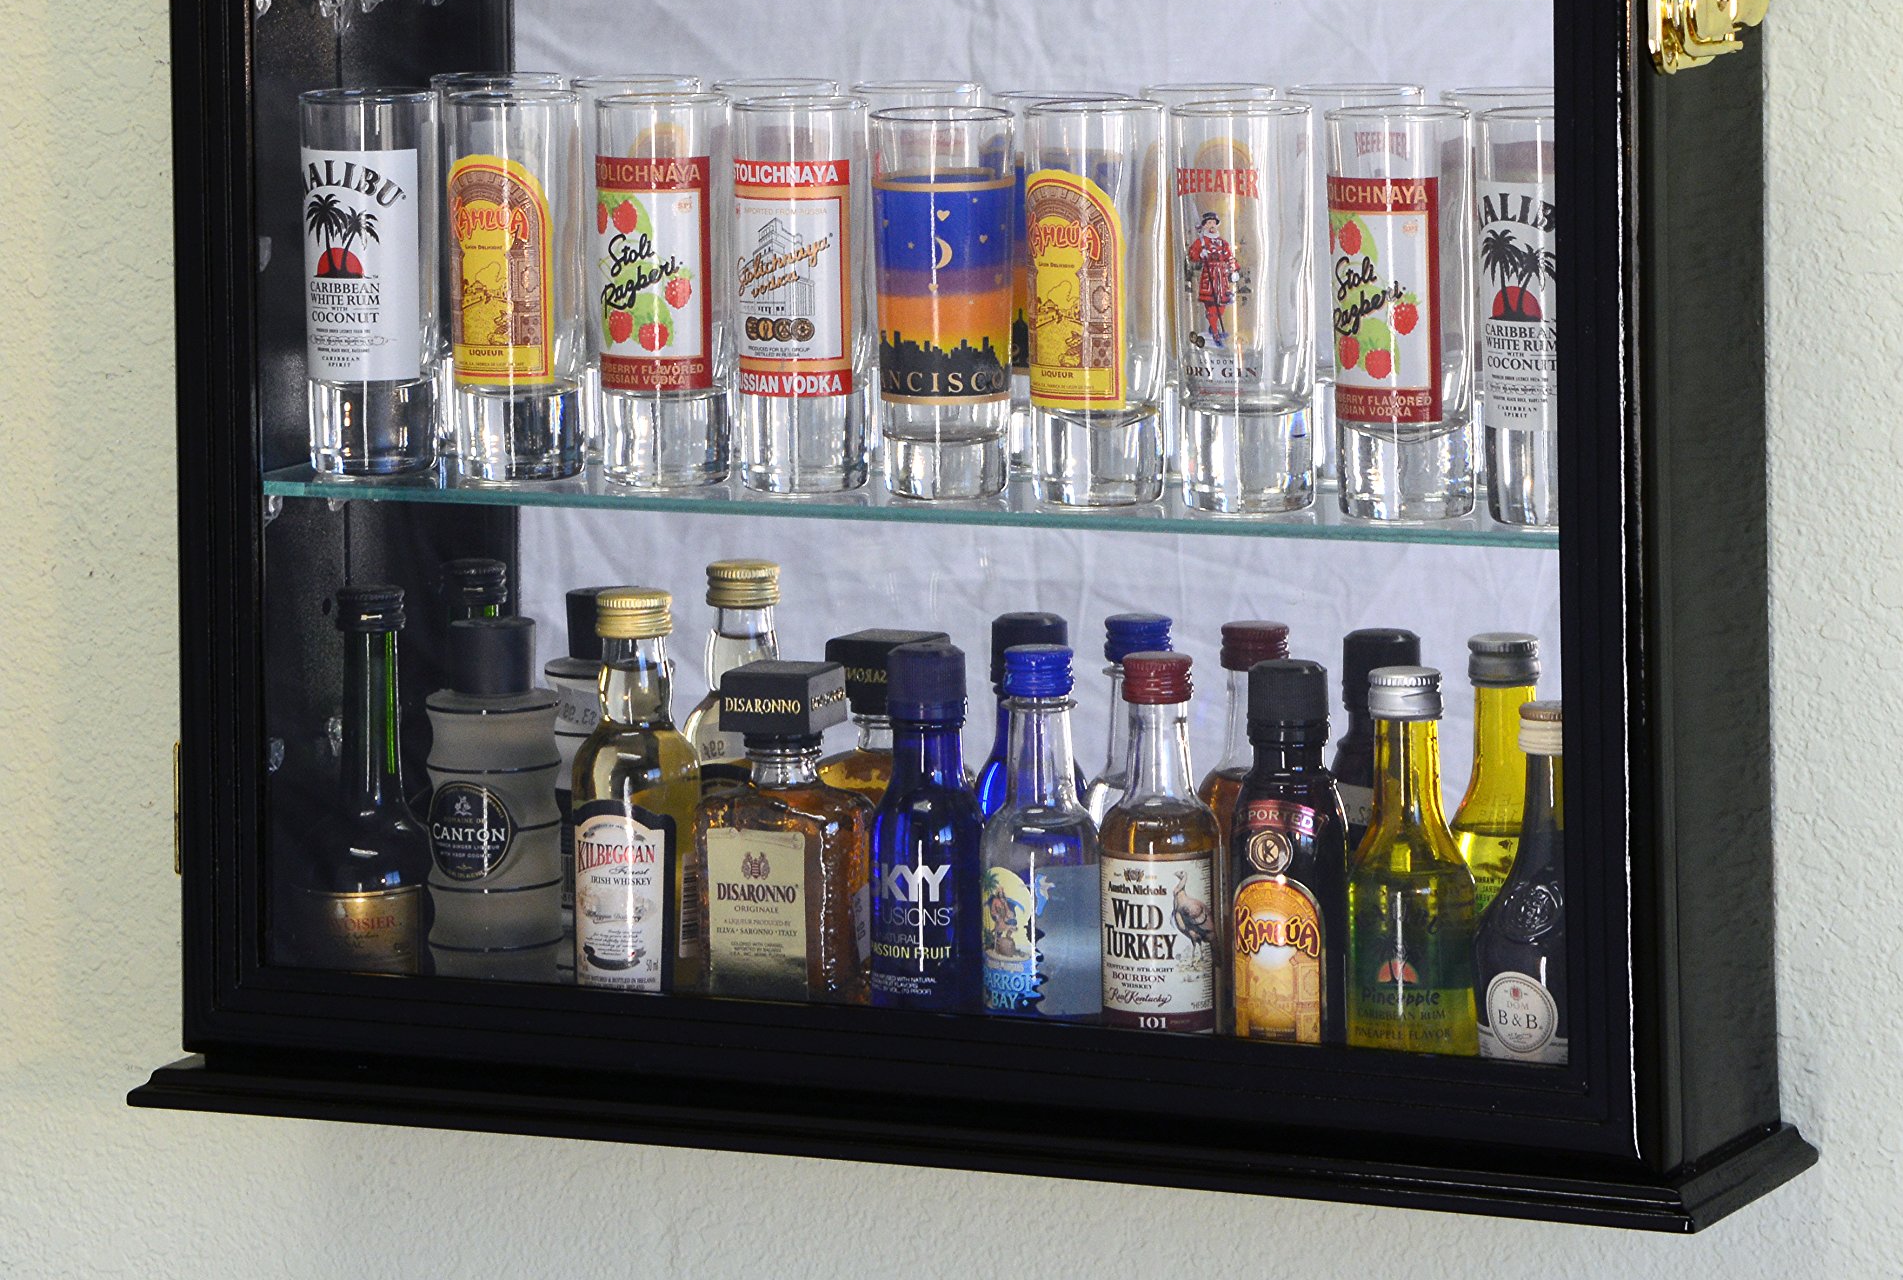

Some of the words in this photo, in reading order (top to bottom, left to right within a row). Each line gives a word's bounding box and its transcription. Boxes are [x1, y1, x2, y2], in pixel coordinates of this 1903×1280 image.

[1177, 167, 1259, 199] BEEFEATER
[609, 234, 655, 278] Stoli
[1335, 255, 1377, 301] Stoli
[310, 283, 380, 294] CARIBBEAN
[310, 294, 344, 306] WHITE
[347, 295, 380, 306] RUM
[312, 311, 380, 324] COCONUT
[1487, 337, 1521, 352] WHITE
[469, 349, 504, 358] LIQUEUR
[642, 363, 703, 374] FLAVORED
[1487, 356, 1557, 371] COCONUT
[1041, 370, 1073, 380] LIQUEUR
[783, 375, 842, 394] VODKA
[1369, 406, 1411, 418] VODKA
[725, 697, 801, 715] DISARONNO
[432, 822, 506, 842] CANTON
[577, 839, 656, 874] KILBEGGAN
[590, 875, 611, 886] IRISH
[612, 876, 652, 886] WHISKEY
[716, 882, 796, 904] DISARONNO
[1132, 883, 1167, 896] Nichols
[734, 905, 779, 914] ORIGINALE
[1111, 897, 1163, 930] WILD
[740, 928, 773, 936] SARONNO
[1105, 923, 1177, 962] TURKEY
[914, 946, 951, 960] FRUIT
[1112, 971, 1166, 983] BOURBON
[1122, 982, 1152, 990] WHISKEY
[992, 991, 1018, 1010] BAY
[1507, 1000, 1529, 1010] DOM
[1138, 1016, 1168, 1029] 101
[1512, 1013, 1522, 1027] &
